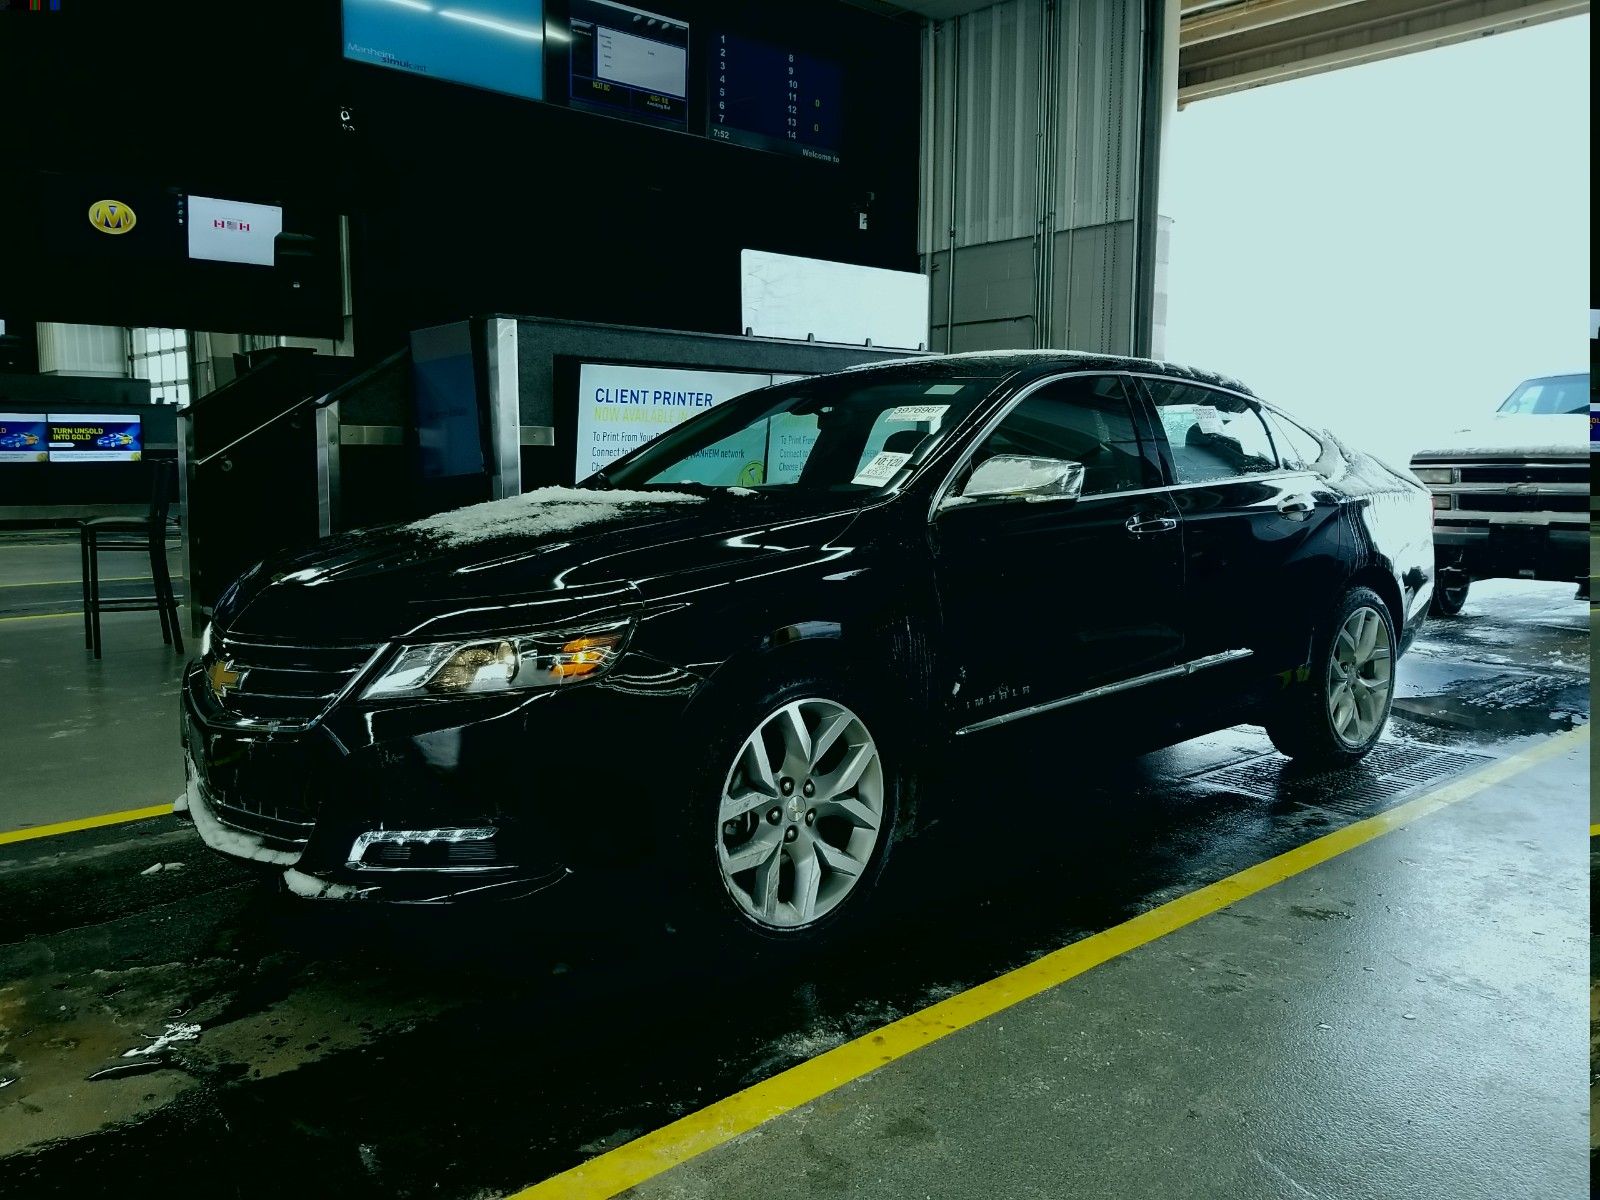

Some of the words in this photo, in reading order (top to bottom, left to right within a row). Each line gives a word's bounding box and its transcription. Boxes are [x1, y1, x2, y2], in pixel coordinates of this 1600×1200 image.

[720, 35, 726, 44] 1
[720, 48, 726, 57] 2
[788, 54, 795, 63] 8
[720, 61, 726, 70] 3
[788, 67, 794, 75] 9
[719, 75, 726, 84] 4
[788, 80, 798, 89] 10
[719, 87, 725, 97] 5
[788, 92, 797, 102] 11
[719, 101, 725, 110] 6
[787, 105, 797, 114] 12
[719, 113, 725, 123] 7
[787, 118, 797, 127] 13
[713, 128, 730, 140] 7:52
[786, 130, 797, 140] 14
[802, 148, 832, 162] Welcome
[832, 155, 840, 163] to
[595, 387, 650, 405] CLIENT
[653, 390, 714, 407] PRINTER
[52, 427, 73, 435] TURN
[73, 427, 104, 435] UNSOLD
[592, 431, 601, 442] To
[602, 431, 620, 442] Print
[621, 432, 638, 442] From
[592, 446, 621, 457] Connect
[720, 449, 745, 458] network
[965, 685, 1031, 710] IMPALA
